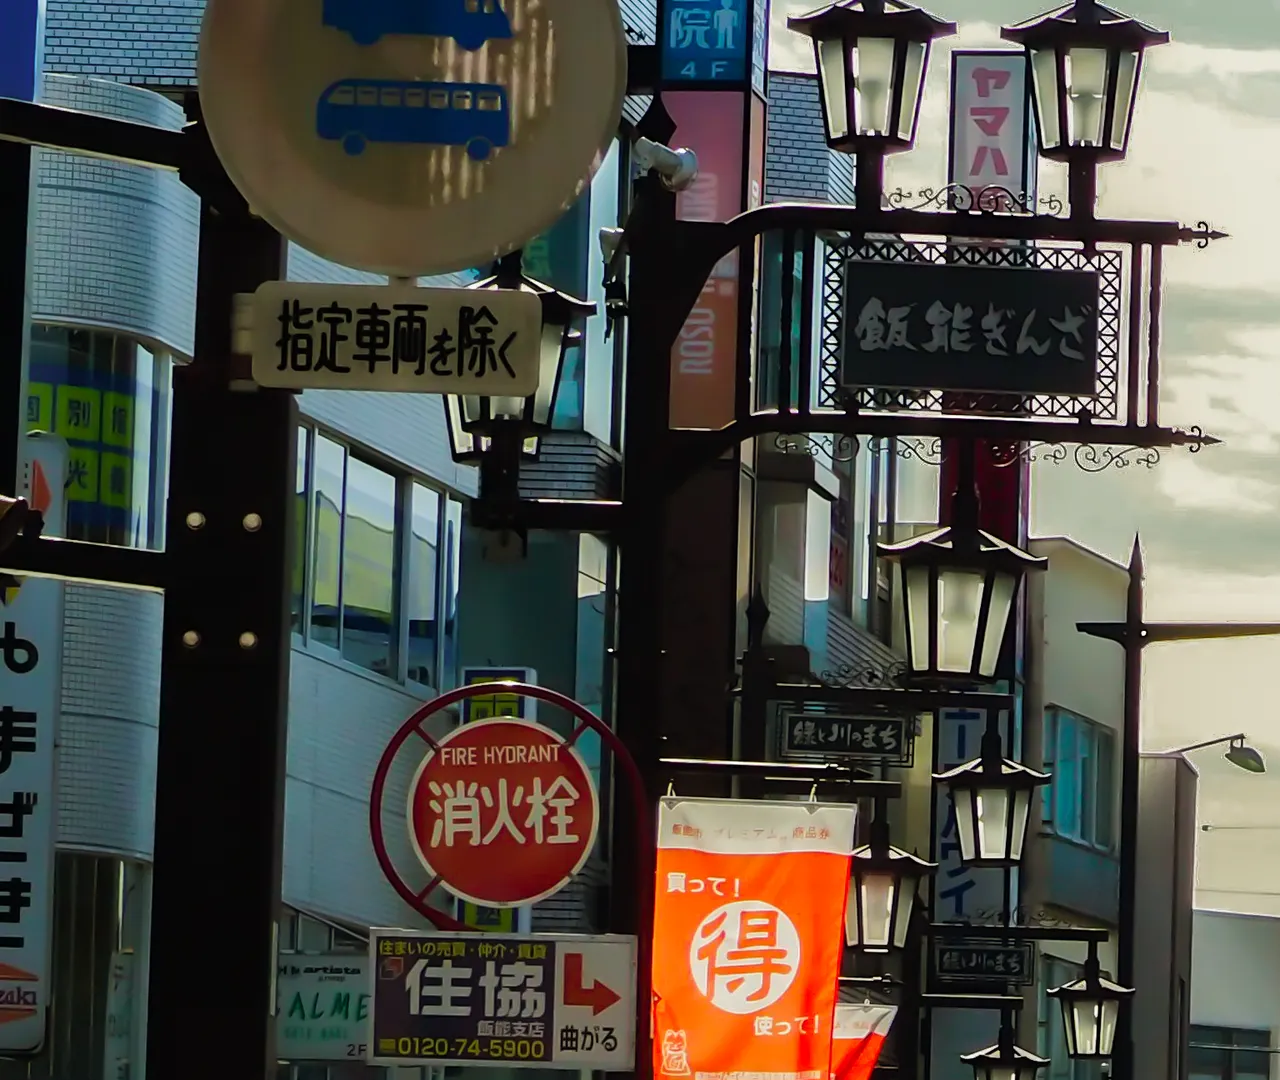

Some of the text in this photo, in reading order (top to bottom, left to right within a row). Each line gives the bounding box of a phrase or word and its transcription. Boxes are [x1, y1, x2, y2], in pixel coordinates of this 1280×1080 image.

[969, 66, 1012, 177] ヤマハ
[276, 299, 518, 379] 指定車両を除く
[854, 296, 1093, 362] 飯能ぎんざ
[440, 743, 562, 767] FIRE HYDRANT
[428, 775, 580, 848] 消火栓
[697, 909, 794, 1002] 得
[277, 991, 372, 1022] ALME
[404, 959, 545, 1018] 住協
[399, 1037, 545, 1059] 0120-74-5900
[559, 1025, 618, 1053] 曲がる
